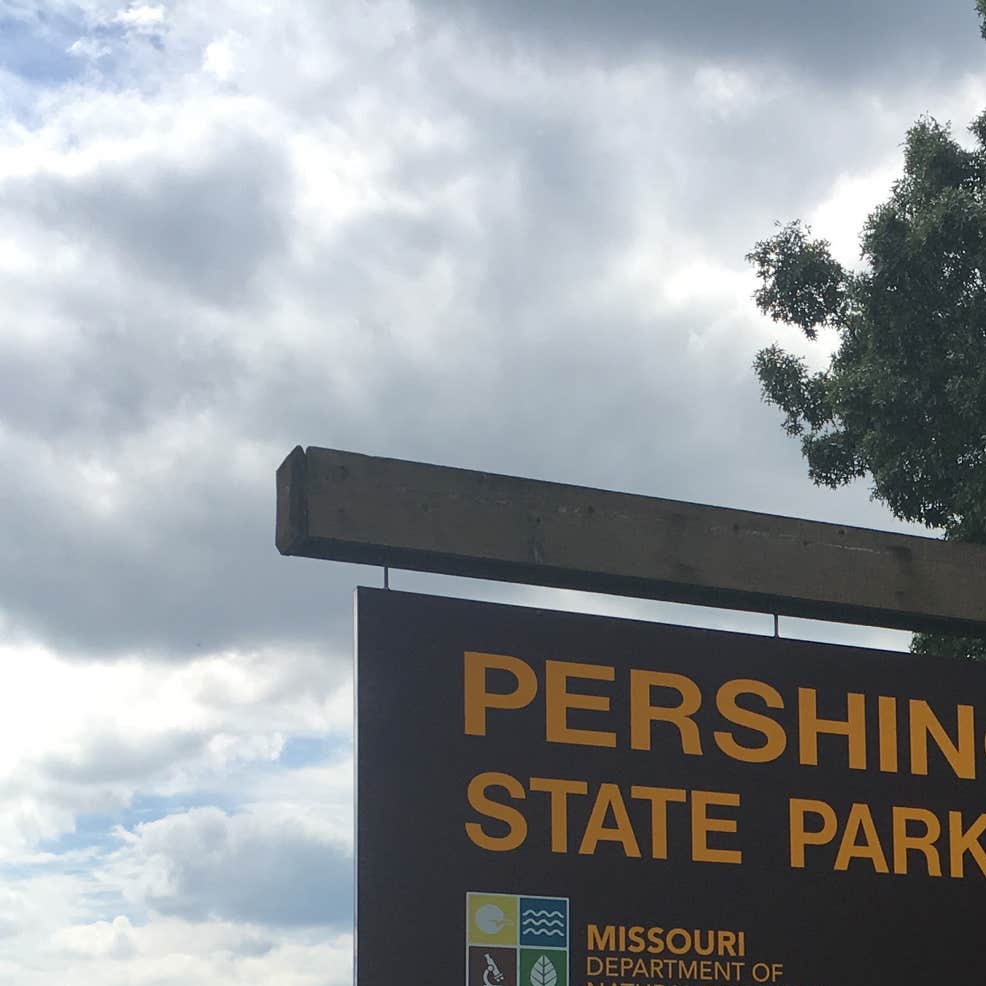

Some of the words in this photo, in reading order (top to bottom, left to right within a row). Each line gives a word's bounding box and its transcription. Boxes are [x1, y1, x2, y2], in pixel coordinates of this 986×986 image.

[465, 772, 743, 865] STATE
[586, 924, 746, 957] MISSOURI
[586, 956, 745, 982] DEPARTMENT
[752, 962, 784, 983] OF
